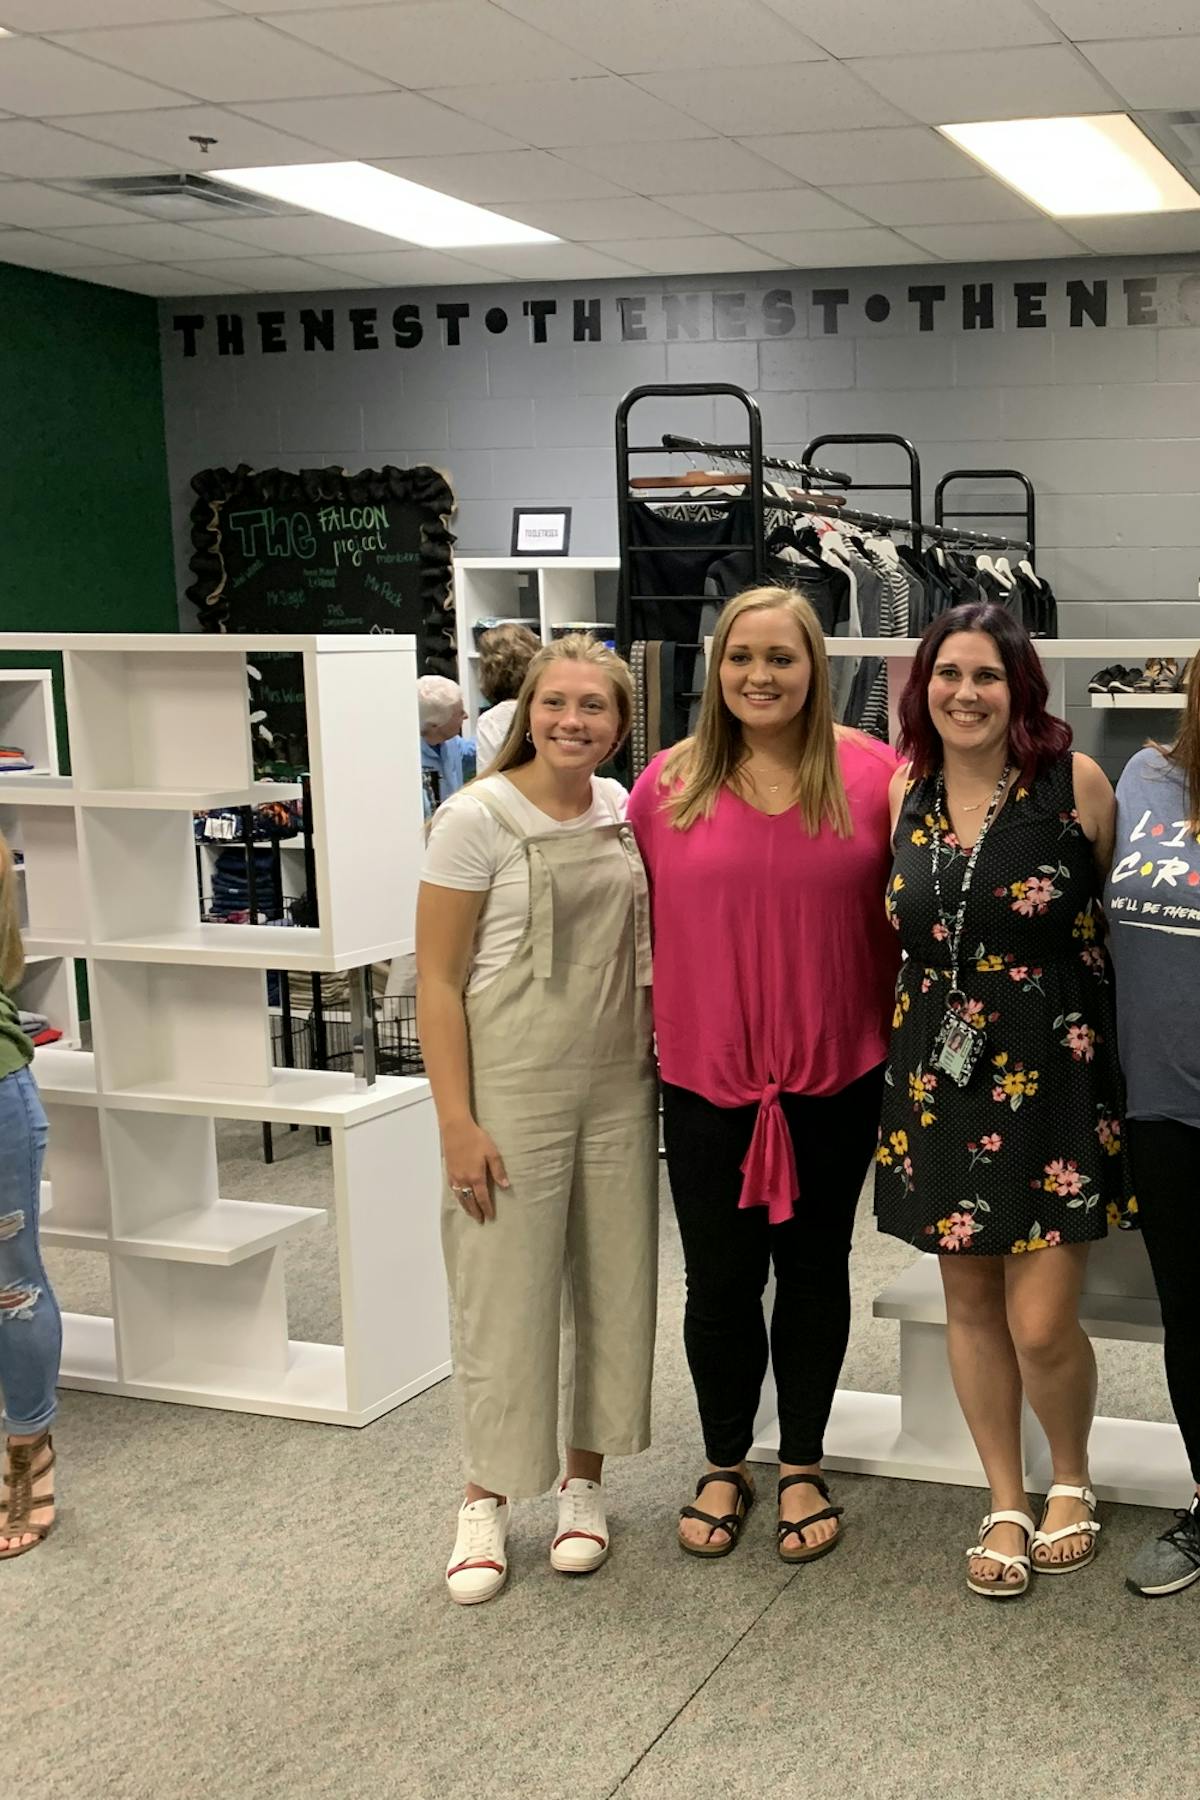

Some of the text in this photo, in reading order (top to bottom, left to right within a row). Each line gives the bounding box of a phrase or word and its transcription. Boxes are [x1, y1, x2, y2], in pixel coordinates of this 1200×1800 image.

[228, 504, 389, 559] The FALCON
[332, 527, 387, 567] project
[1111, 896, 1138, 912] WE'LL
[1142, 901, 1161, 915] BE
